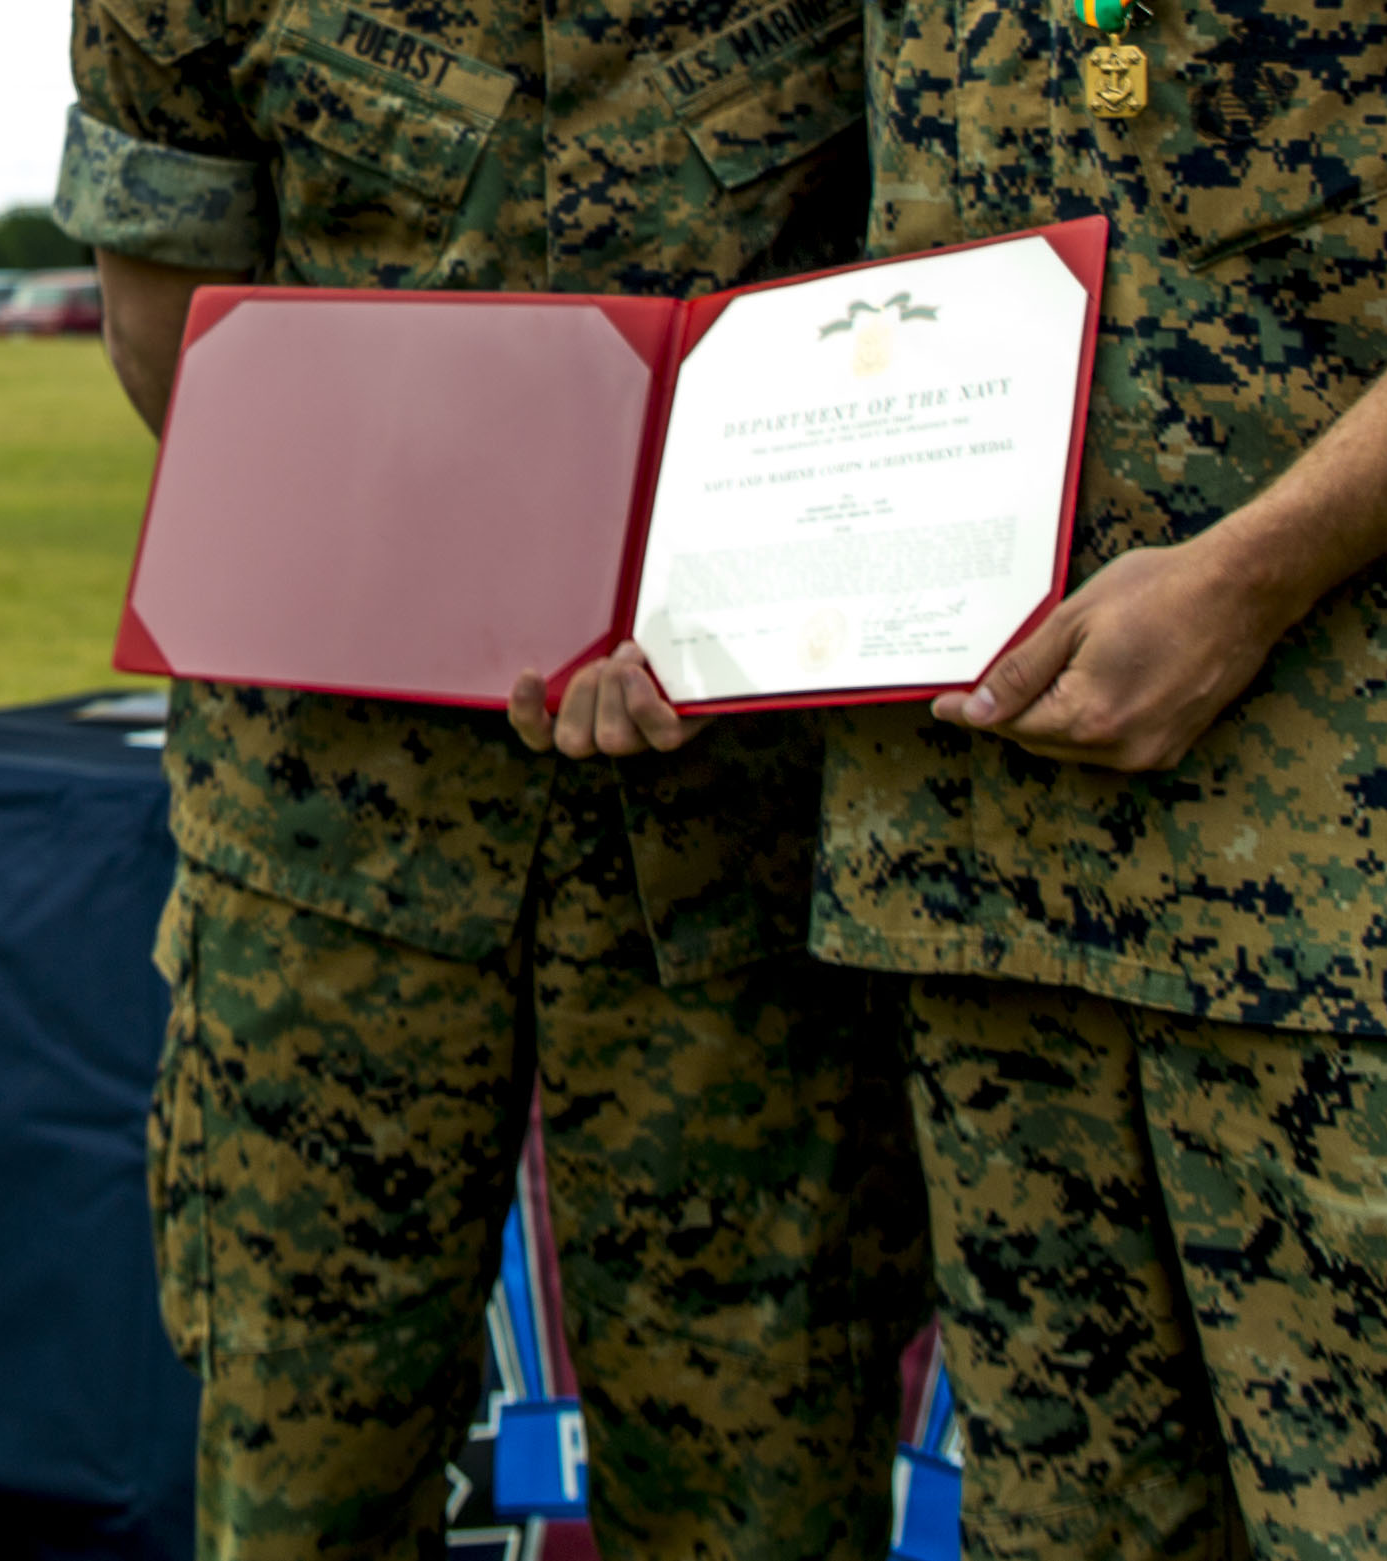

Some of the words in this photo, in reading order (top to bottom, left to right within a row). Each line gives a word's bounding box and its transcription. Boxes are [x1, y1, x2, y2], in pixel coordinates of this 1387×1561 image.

[339, 8, 457, 89] FUERST
[666, 51, 732, 96] U.S.
[723, 402, 860, 439] DEPARTMENT
[867, 395, 898, 417] OF
[907, 388, 950, 410] THE
[958, 376, 1013, 402] NAVY
